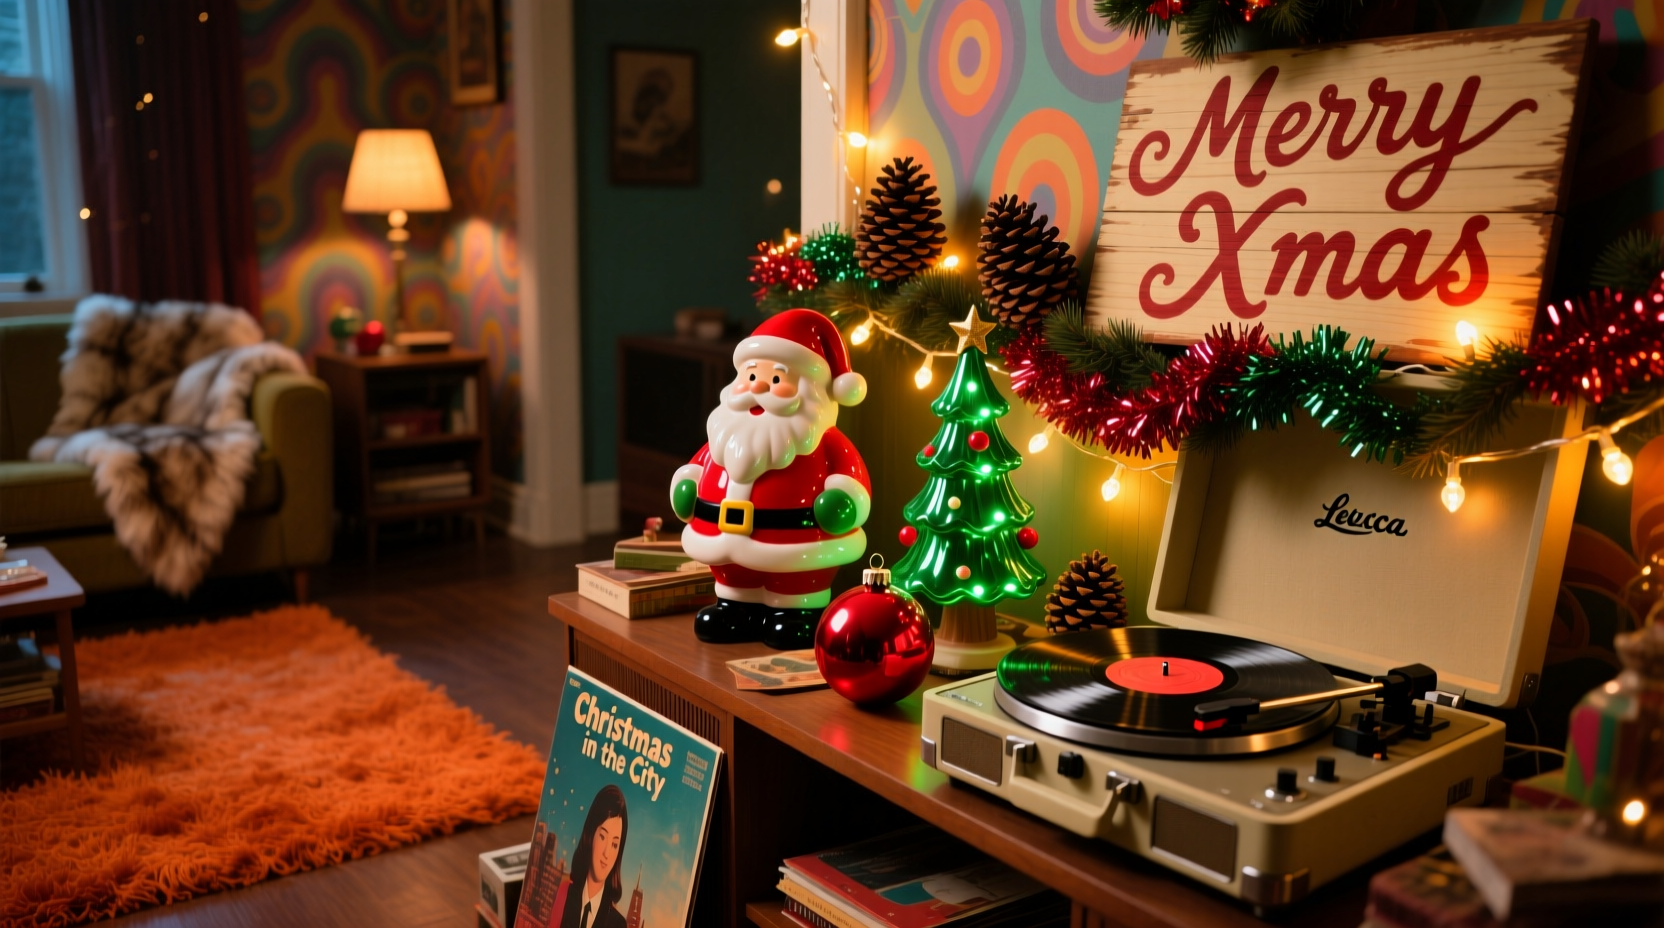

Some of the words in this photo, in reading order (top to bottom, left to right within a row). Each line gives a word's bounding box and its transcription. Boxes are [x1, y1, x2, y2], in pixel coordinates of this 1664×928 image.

[1129, 65, 1538, 211] Merry
[1139, 188, 1490, 319] Xmas
[574, 691, 673, 768] Christmas
[581, 730, 598, 760] in
[601, 741, 626, 775] the
[629, 756, 666, 802] City
